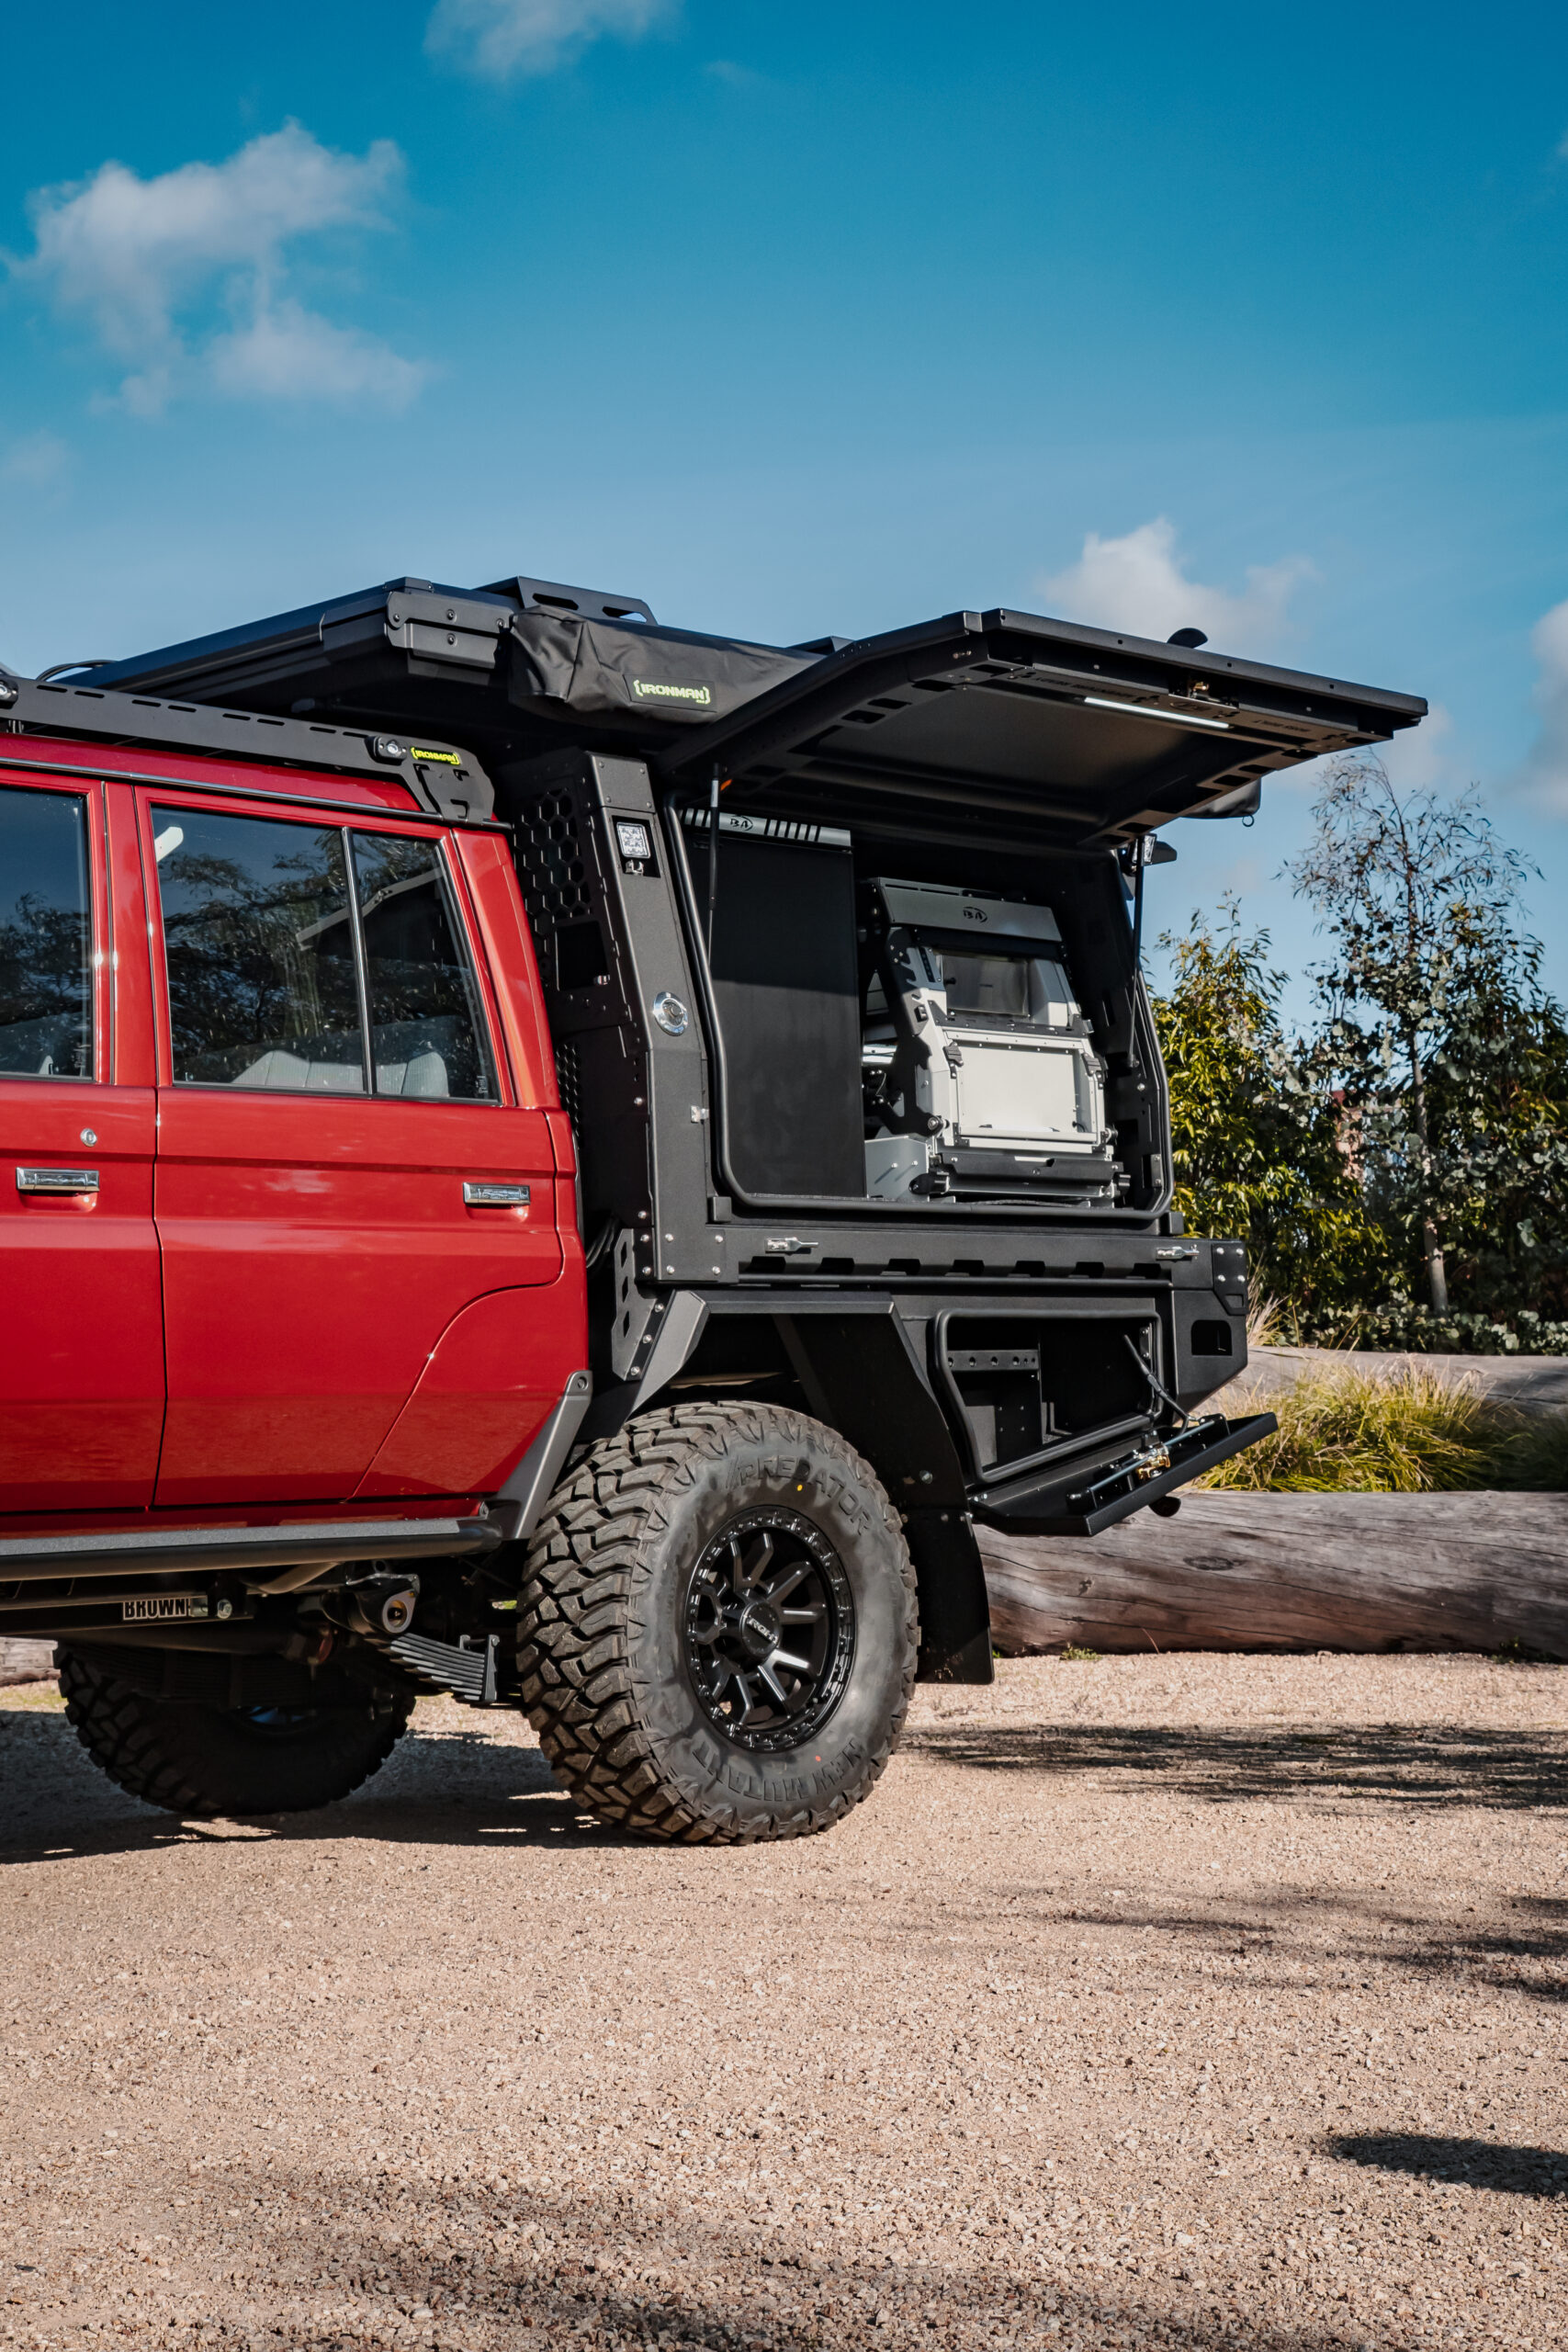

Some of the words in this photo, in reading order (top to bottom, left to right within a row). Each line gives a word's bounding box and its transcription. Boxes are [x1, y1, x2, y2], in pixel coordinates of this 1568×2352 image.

[637, 682, 706, 701] IRONMAN
[413, 749, 457, 763] IRONMAN
[737, 1454, 870, 1536] PREDATOR
